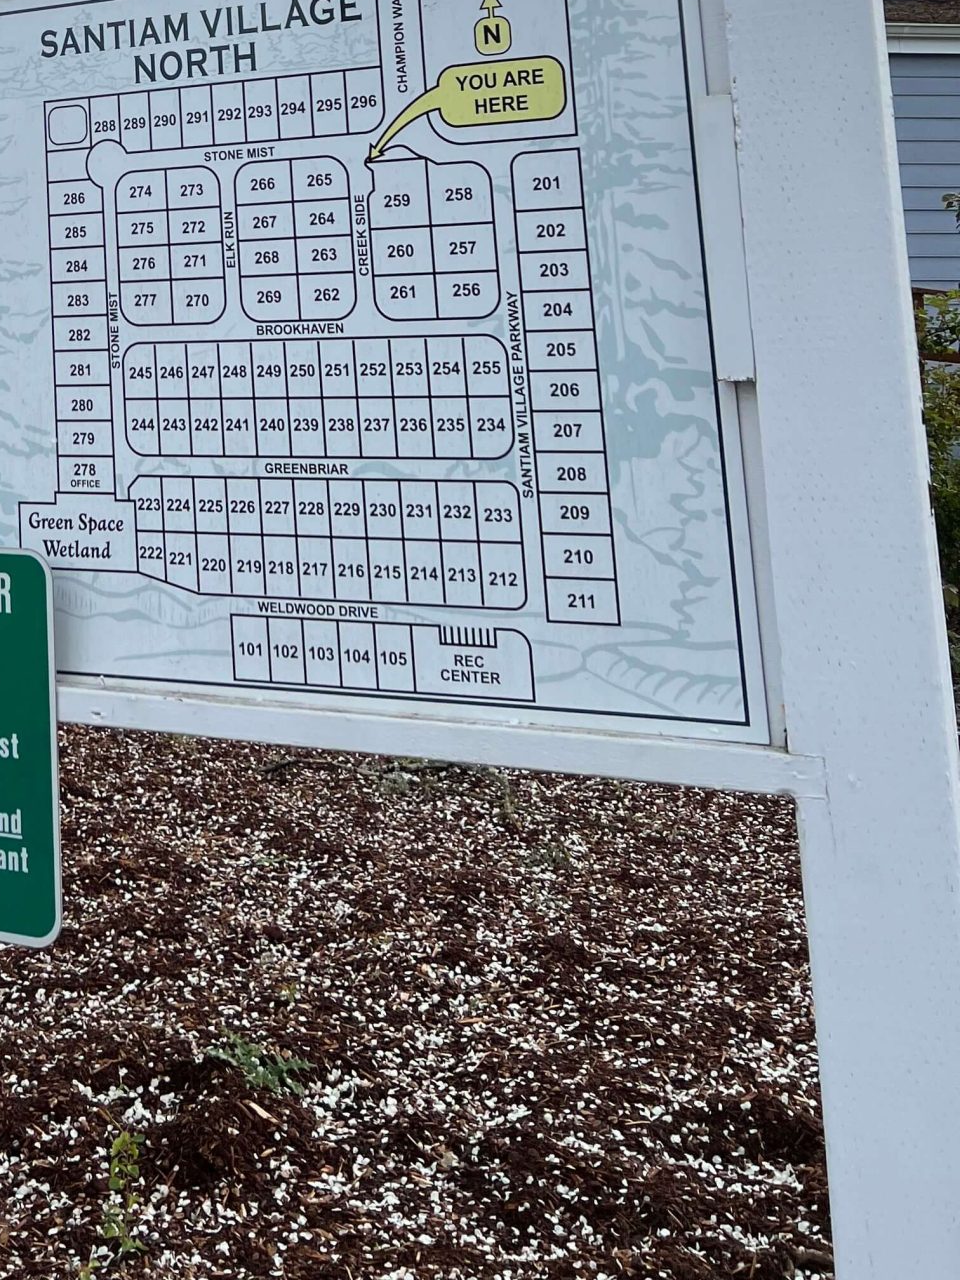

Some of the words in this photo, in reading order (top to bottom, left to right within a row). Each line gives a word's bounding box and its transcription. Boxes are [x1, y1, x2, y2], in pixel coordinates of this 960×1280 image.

[40, 12, 189, 58] SANTIAM
[483, 24, 501, 45] N
[133, 42, 257, 84] NORTH
[394, 21, 408, 93] CHAMPION
[455, 72, 497, 91] YOU
[503, 68, 544, 87] ARE
[316, 98, 342, 112] 295
[350, 94, 377, 109] 296
[474, 94, 529, 115] HERE
[218, 107, 242, 121] 292
[248, 104, 272, 119] 293
[94, 119, 116, 133] 288
[123, 116, 146, 130] 289
[153, 114, 176, 127] 290
[204, 149, 244, 162] STONE
[247, 146, 275, 159] MIST
[250, 177, 275, 191] 266
[307, 173, 332, 187] 265
[532, 176, 560, 191] 201
[129, 185, 152, 198] 274
[180, 183, 204, 197] 273
[445, 187, 473, 202] 258
[63, 192, 85, 205] 286
[384, 193, 410, 208] 259
[354, 194, 366, 226] SIDE
[223, 211, 234, 239] RUN
[309, 212, 335, 226] 264
[65, 226, 87, 239] 285
[131, 222, 154, 235] 275
[182, 220, 206, 234] 272
[536, 223, 566, 238] 202
[225, 242, 236, 268] ELK
[254, 250, 279, 264] 268
[356, 229, 369, 276] CREEK
[387, 244, 414, 258] 260
[539, 262, 569, 277] 203
[257, 290, 282, 304] 269
[314, 288, 340, 302] 262
[390, 285, 416, 299] 261
[452, 283, 481, 297] 256
[67, 294, 89, 307] 283
[109, 292, 119, 321] MIST
[134, 294, 157, 307] 277
[186, 294, 209, 307] 270
[543, 302, 573, 317] 204
[256, 322, 344, 336] BROOKHAVEN
[506, 291, 523, 361] PARKWAY
[68, 329, 91, 342] 282
[110, 326, 120, 369] STONE
[129, 366, 152, 379] 245
[160, 366, 184, 379] 246
[222, 365, 247, 378] 248
[289, 364, 315, 377] 250
[360, 362, 387, 376] 252
[432, 361, 461, 375] 254
[472, 361, 501, 375] 255
[513, 365, 527, 429] VILLAGE
[550, 383, 580, 397] 206
[71, 399, 93, 412] 280
[131, 418, 155, 431] 244
[194, 418, 219, 431] 242
[259, 418, 285, 432] 240
[328, 418, 355, 432] 238
[400, 418, 427, 432] 236
[477, 417, 506, 432] 234
[553, 423, 582, 438] 207
[72, 432, 95, 445] 279
[74, 463, 96, 476] 278
[264, 462, 349, 475] GREENBRIAR
[518, 432, 534, 498] SANTIAM
[70, 479, 100, 488] OFFICE
[137, 497, 161, 511] 223
[198, 499, 223, 513] 225
[265, 501, 290, 515] 227
[334, 502, 360, 516] 229
[406, 504, 432, 518] 231
[484, 508, 513, 523] 233
[560, 505, 590, 520] 209
[29, 512, 73, 530] Green
[78, 513, 124, 535] Space
[43, 540, 111, 559] Wetland
[139, 546, 163, 560] 222
[169, 552, 192, 566] 221
[237, 559, 262, 574] 219
[302, 562, 328, 576] 217
[373, 565, 401, 579] 215
[448, 567, 476, 583] 213
[488, 571, 518, 587] 212
[567, 593, 595, 609] 211
[257, 601, 335, 616] WELDWOOD
[338, 605, 378, 619] DRIVE
[239, 642, 262, 656] 101
[273, 644, 299, 659] 102
[309, 646, 334, 661] 103
[344, 648, 370, 664] 104
[380, 650, 407, 666] 105
[454, 654, 484, 668] REC
[440, 669, 501, 685] CENTER
